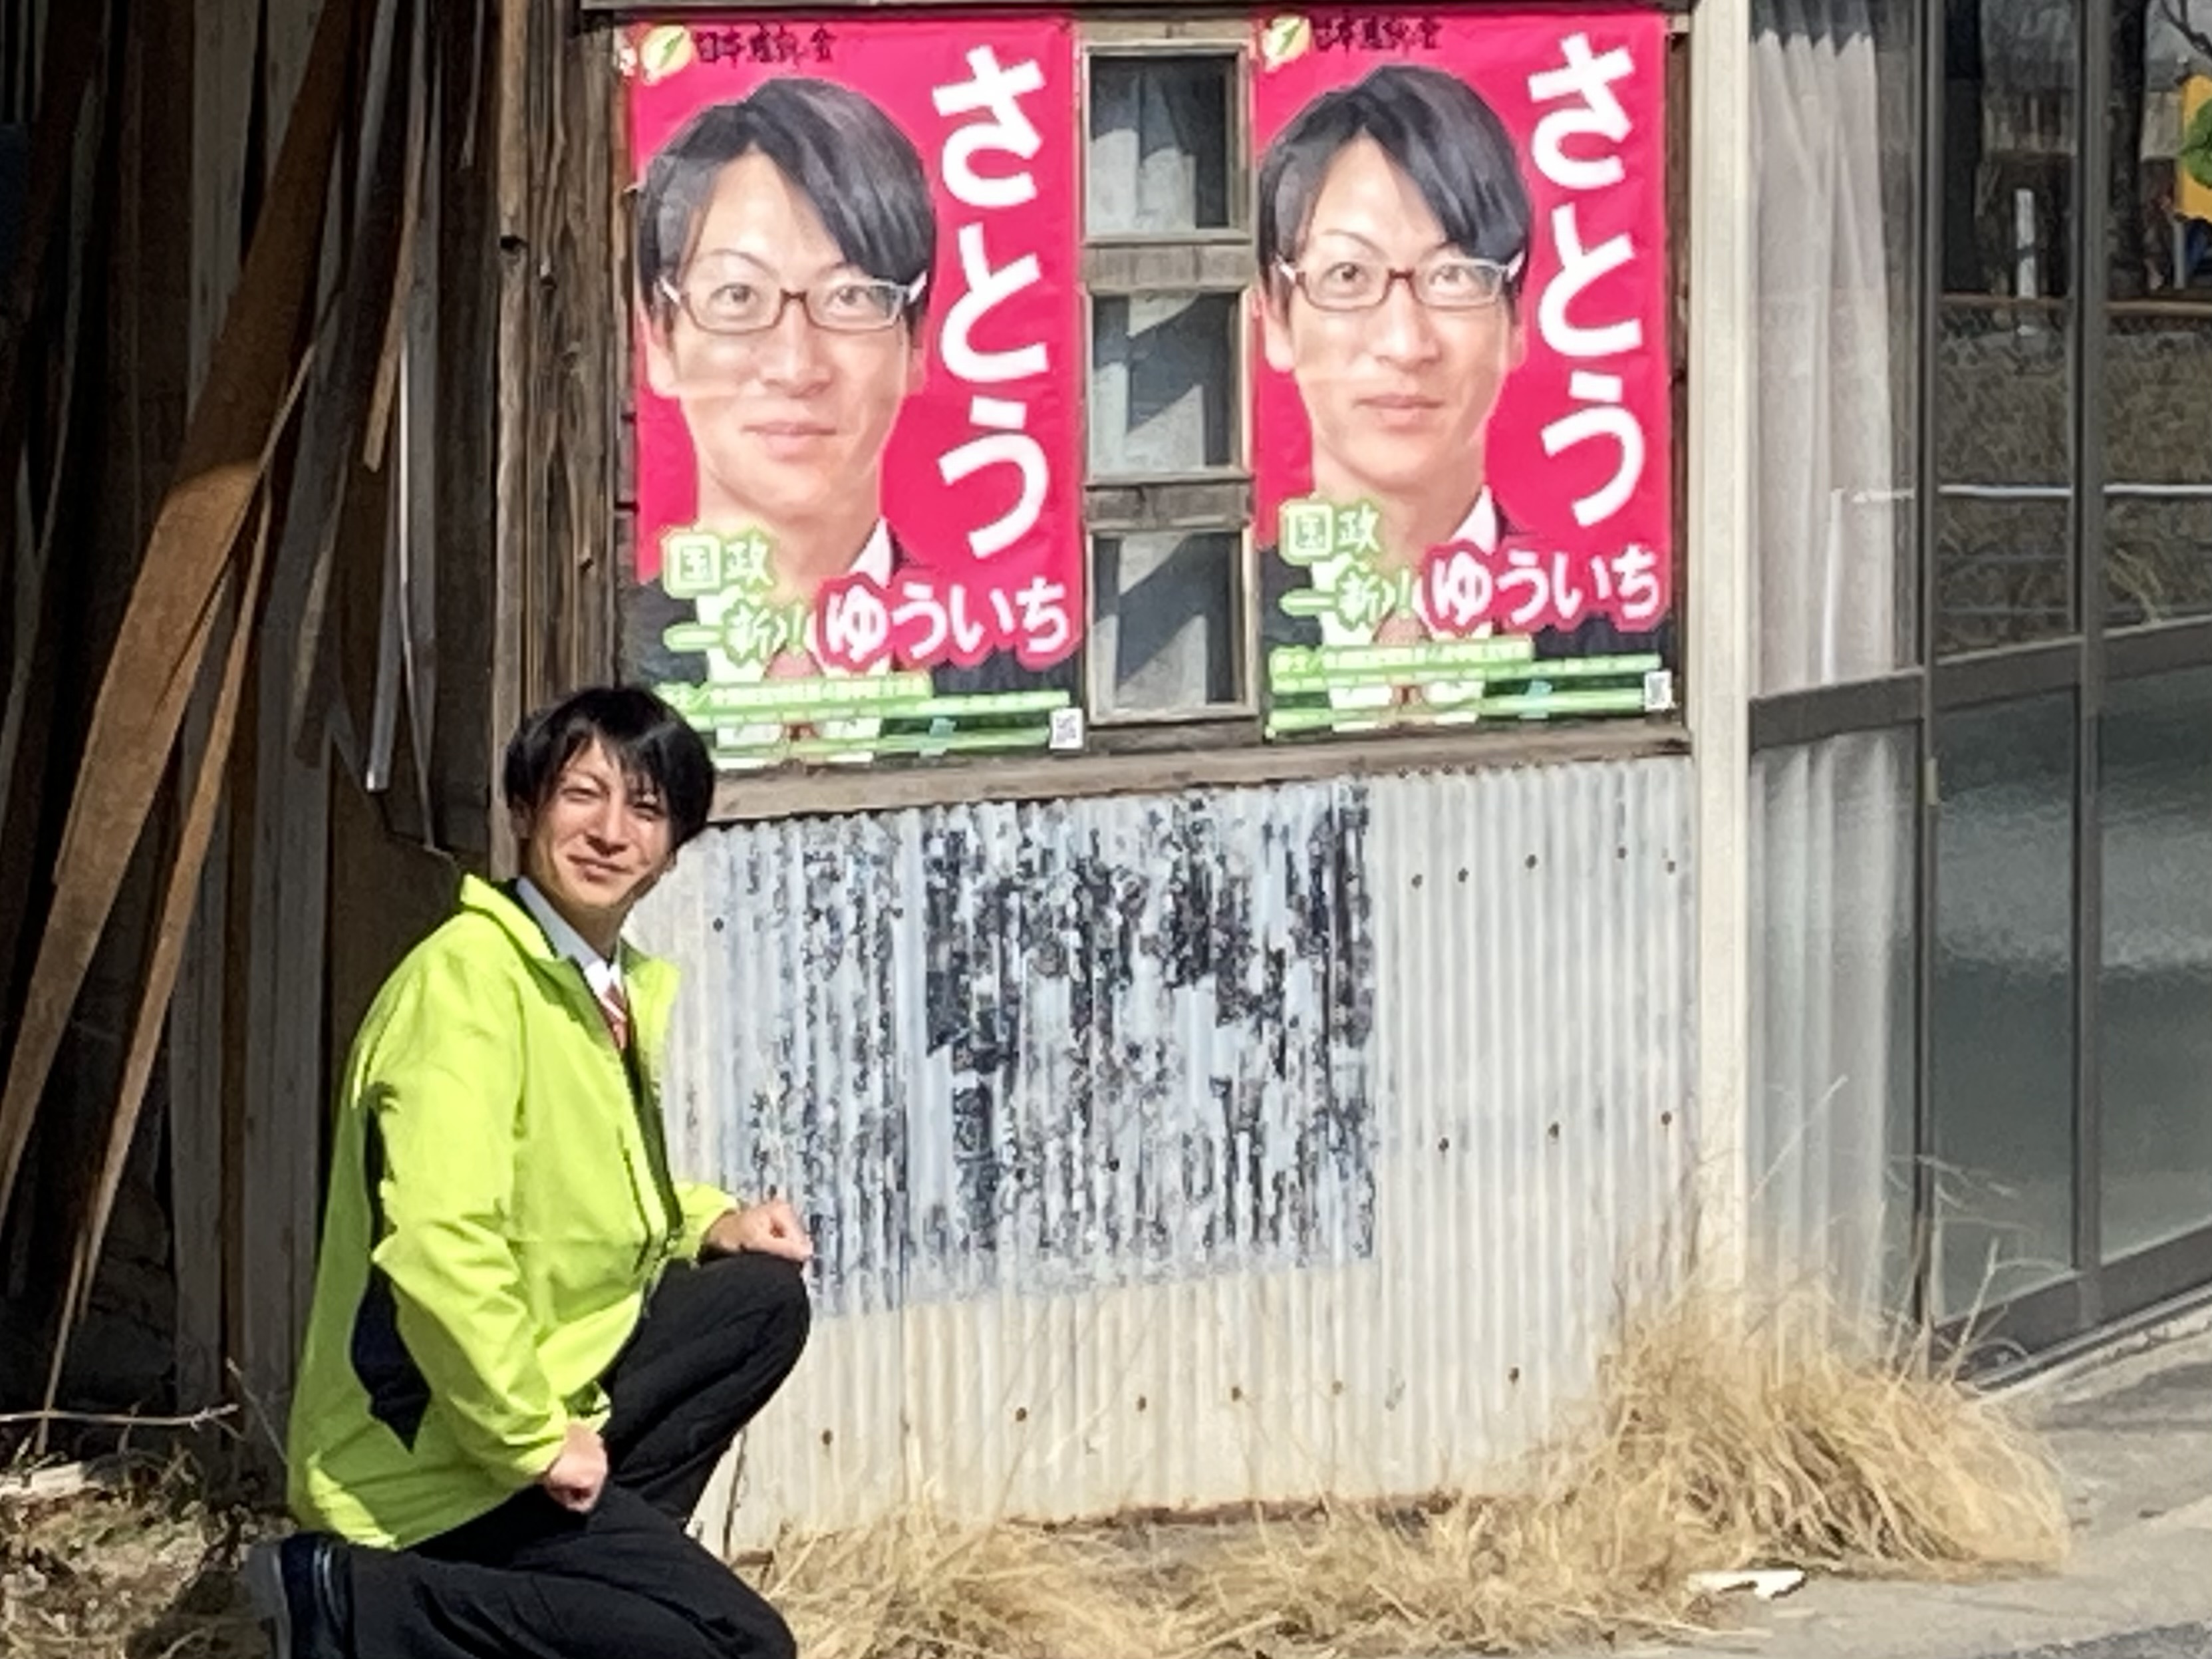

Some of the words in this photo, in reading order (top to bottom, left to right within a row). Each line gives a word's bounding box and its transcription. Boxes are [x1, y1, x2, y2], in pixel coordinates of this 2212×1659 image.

[932, 45, 1049, 559] さとう
[1527, 32, 1645, 527] さとう
[668, 534, 775, 588] 国政
[1287, 504, 1382, 553] 国政
[825, 576, 1068, 663] ゆういち
[1431, 543, 1660, 625] ゆういち
